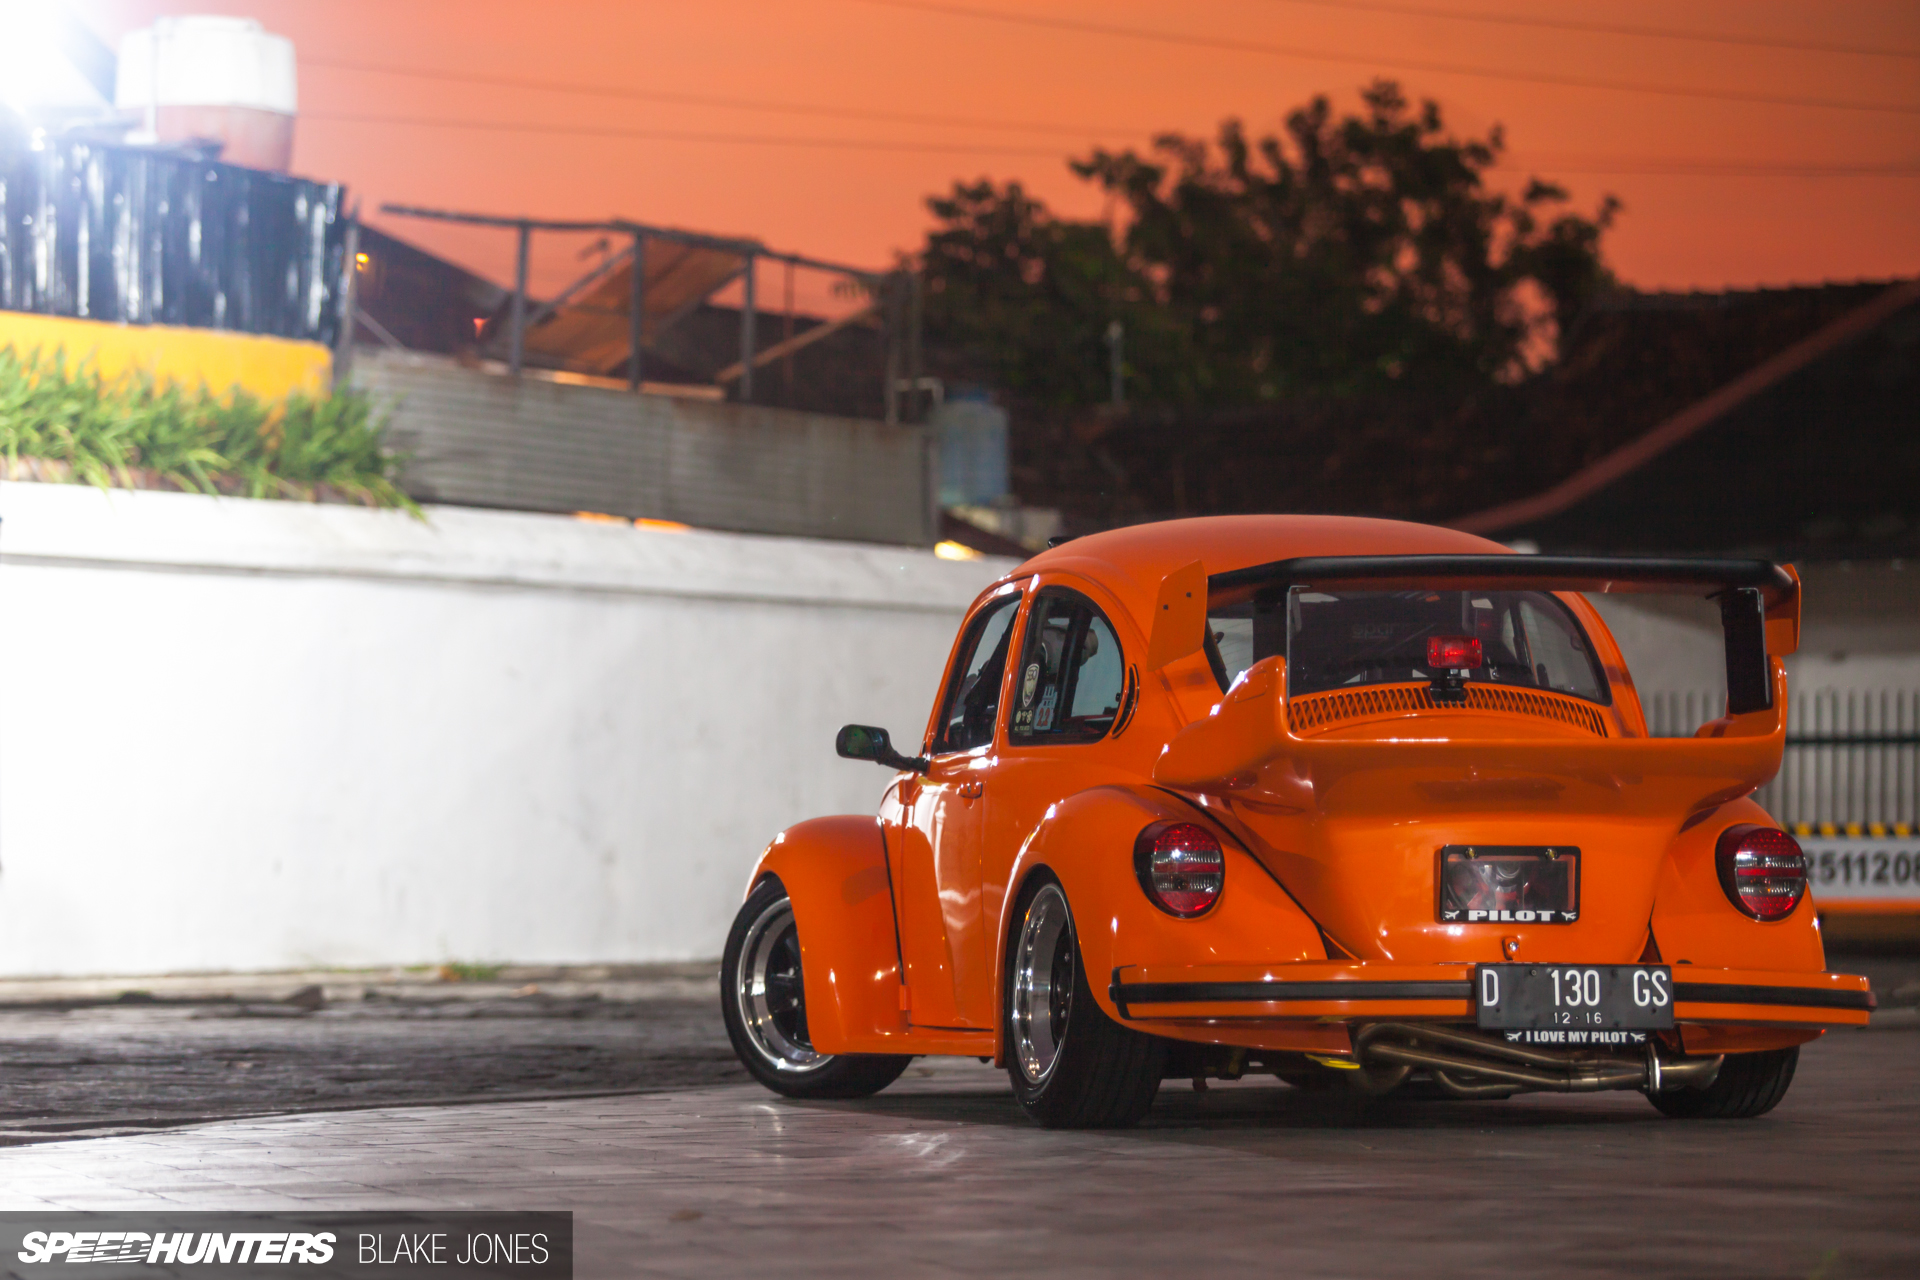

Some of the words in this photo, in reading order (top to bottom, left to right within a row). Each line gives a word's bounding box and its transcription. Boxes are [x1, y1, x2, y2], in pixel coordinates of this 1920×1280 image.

[1468, 909, 1556, 922] PILOT
[1482, 969, 1499, 1006] D
[1551, 969, 1600, 1006] 130
[1633, 970, 1669, 1006] GS
[1525, 1030, 1531, 1042] I
[1533, 1030, 1566, 1042] LOVE
[1567, 1031, 1589, 1043] MY
[1590, 1031, 1628, 1043] PILOT
